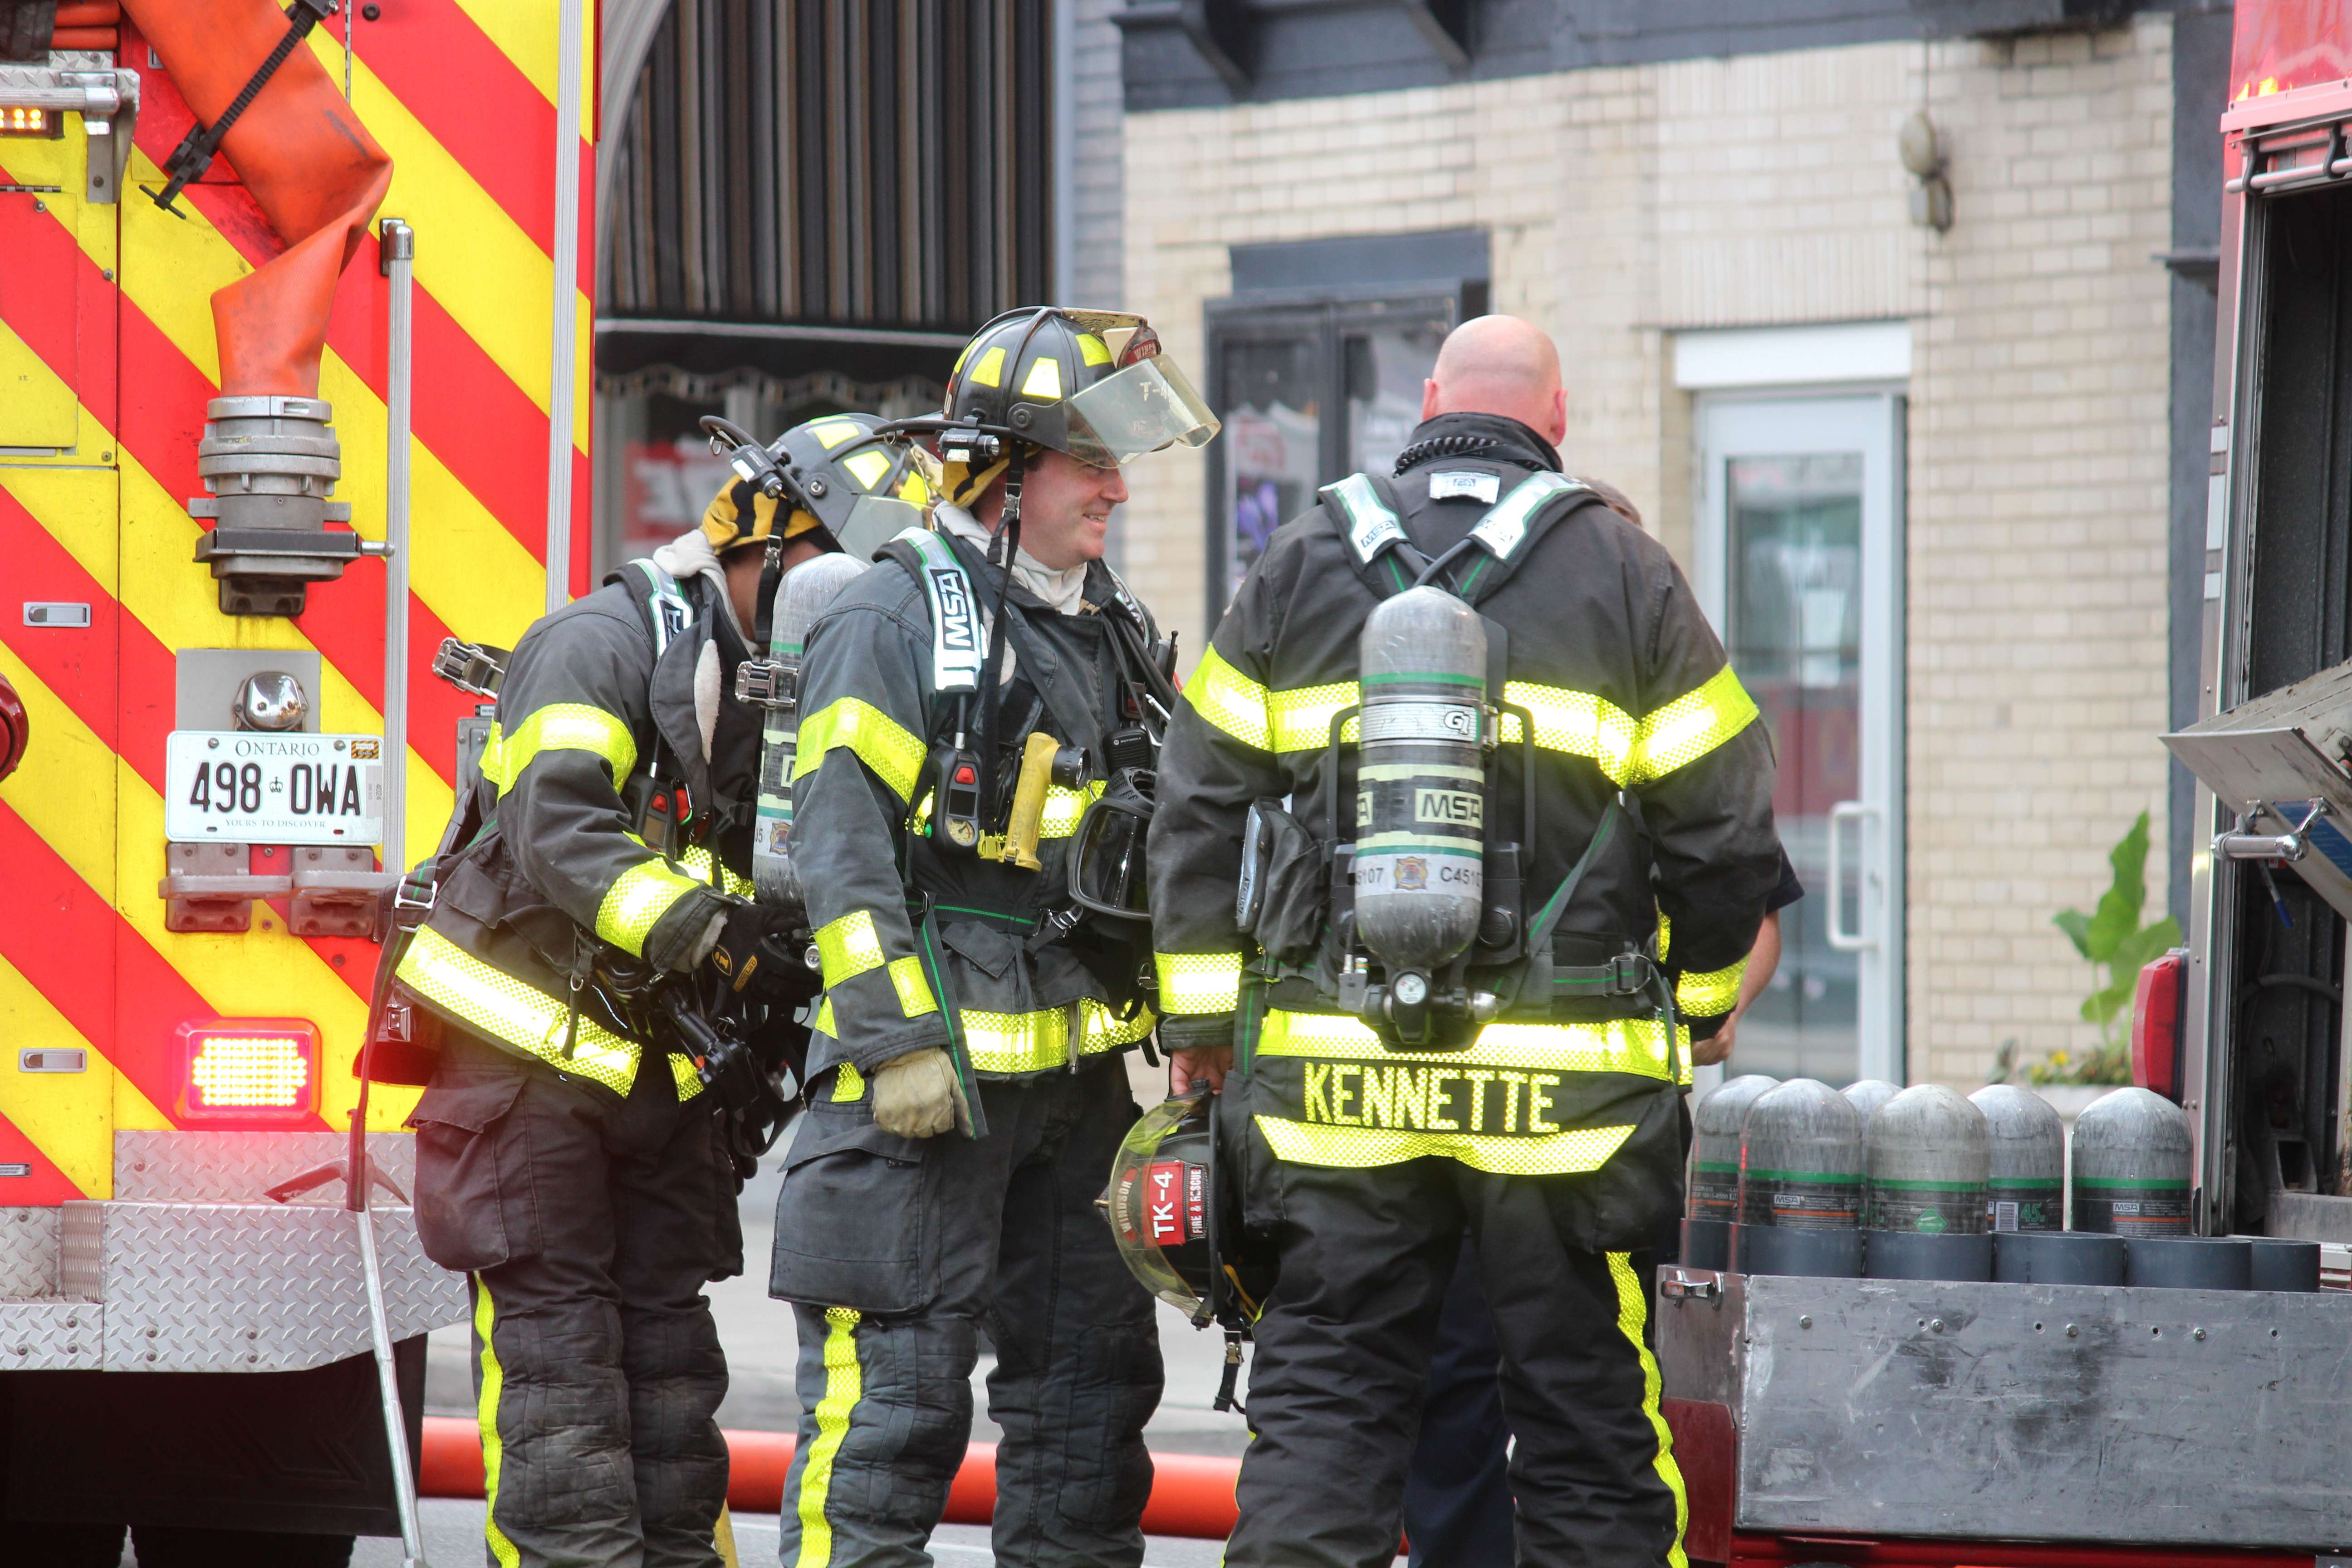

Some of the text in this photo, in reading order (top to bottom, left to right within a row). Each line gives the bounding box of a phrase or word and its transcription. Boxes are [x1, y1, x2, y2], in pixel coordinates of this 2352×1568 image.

[1362, 521, 1396, 547] MSA
[936, 572, 972, 647] MSA
[235, 740, 319, 758] ONTARIO
[190, 762, 262, 813] 498
[1422, 794, 1481, 820] MSA
[278, 820, 326, 828] DISCOVER
[1304, 1062, 1560, 1132] KENNETTE
[1190, 1169, 1202, 1202] RESCUE
[1117, 1181, 1132, 1233] WINDSOR
[1152, 1171, 1175, 1238] TK-4
[1191, 1215, 1203, 1234] FIRE
